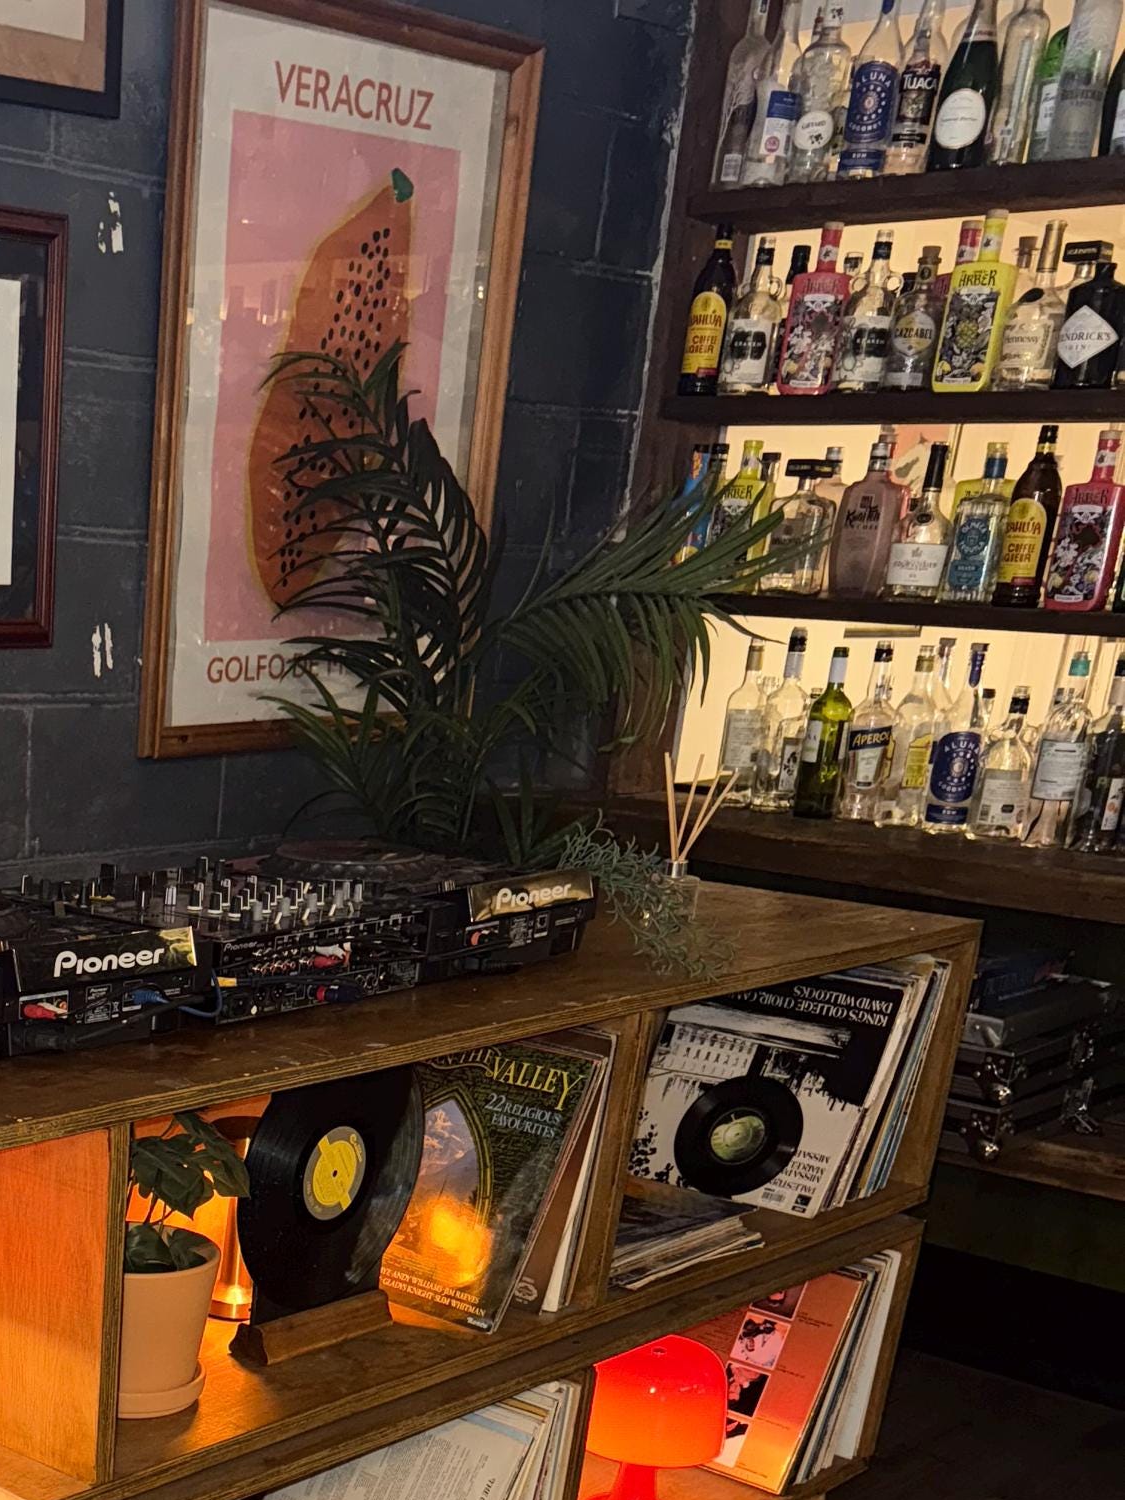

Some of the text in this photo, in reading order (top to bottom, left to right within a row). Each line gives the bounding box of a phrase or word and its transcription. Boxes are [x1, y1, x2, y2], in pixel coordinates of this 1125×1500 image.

[855, 72, 892, 89] ALUNA
[903, 73, 937, 90] TUACA
[275, 60, 434, 131] VERACRUZ
[849, 120, 883, 132] COCONUT
[959, 270, 997, 287] ARBER
[895, 327, 933, 339] CAZCABEL
[1008, 543, 1035, 553] COFFEE
[207, 654, 285, 683] GOLFO
[852, 731, 891, 747] APEROL
[944, 740, 981, 754] ALUNA
[495, 883, 572, 910] Pioneer
[225, 940, 257, 951] Pioneer
[53, 948, 165, 978] Pioneer
[793, 985, 893, 1014] DAVID WILLCOCKS
[796, 999, 848, 1019] COLLEGE
[848, 1010, 889, 1027] KING'S
[488, 1056, 586, 1111] VALLEY
[485, 1093, 562, 1124] 22 RELIGIOUS
[491, 1113, 557, 1139] FAVOURITES
[393, 1270, 412, 1283] ANDY
[412, 1276, 442, 1293] WILLIAMS
[456, 1290, 480, 1304] REEVES
[381, 1278, 406, 1292] GLADYS
[406, 1286, 433, 1300] KNIGHT
[451, 1299, 486, 1317] WHITMAN
[483, 1477, 496, 1496] THE
